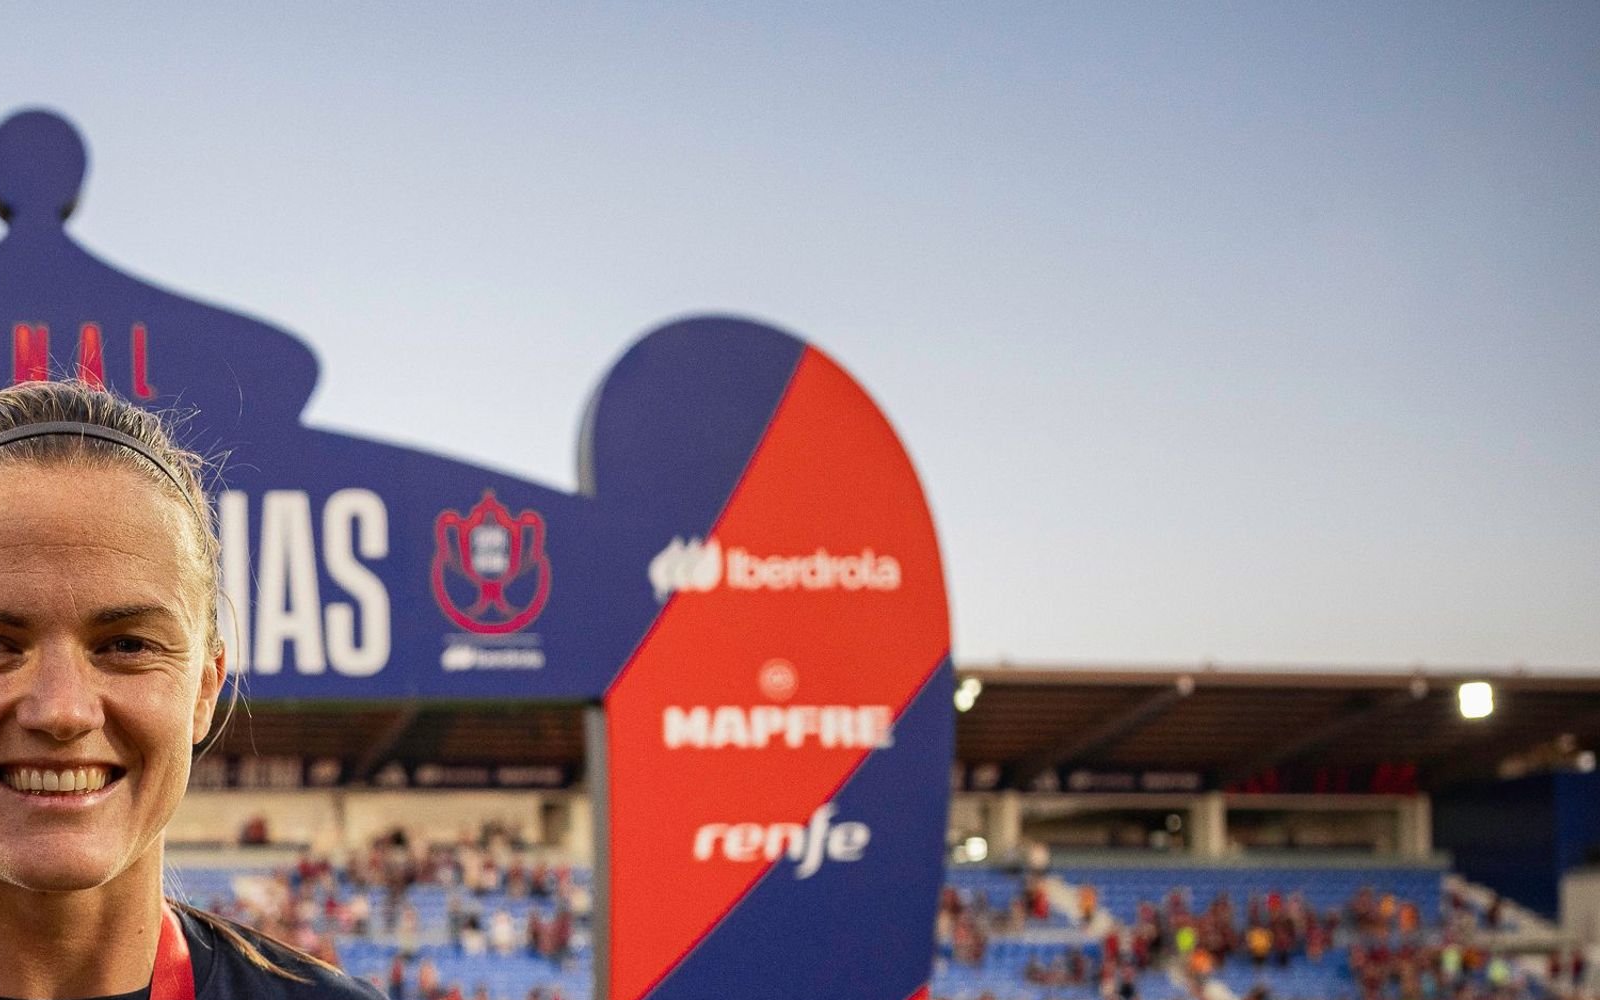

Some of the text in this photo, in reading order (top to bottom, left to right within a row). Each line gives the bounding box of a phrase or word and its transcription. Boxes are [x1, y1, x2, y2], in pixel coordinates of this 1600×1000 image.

[726, 547, 901, 592] Iberdrola
[663, 705, 895, 750] MAPFRE
[693, 801, 871, 880] renfe
